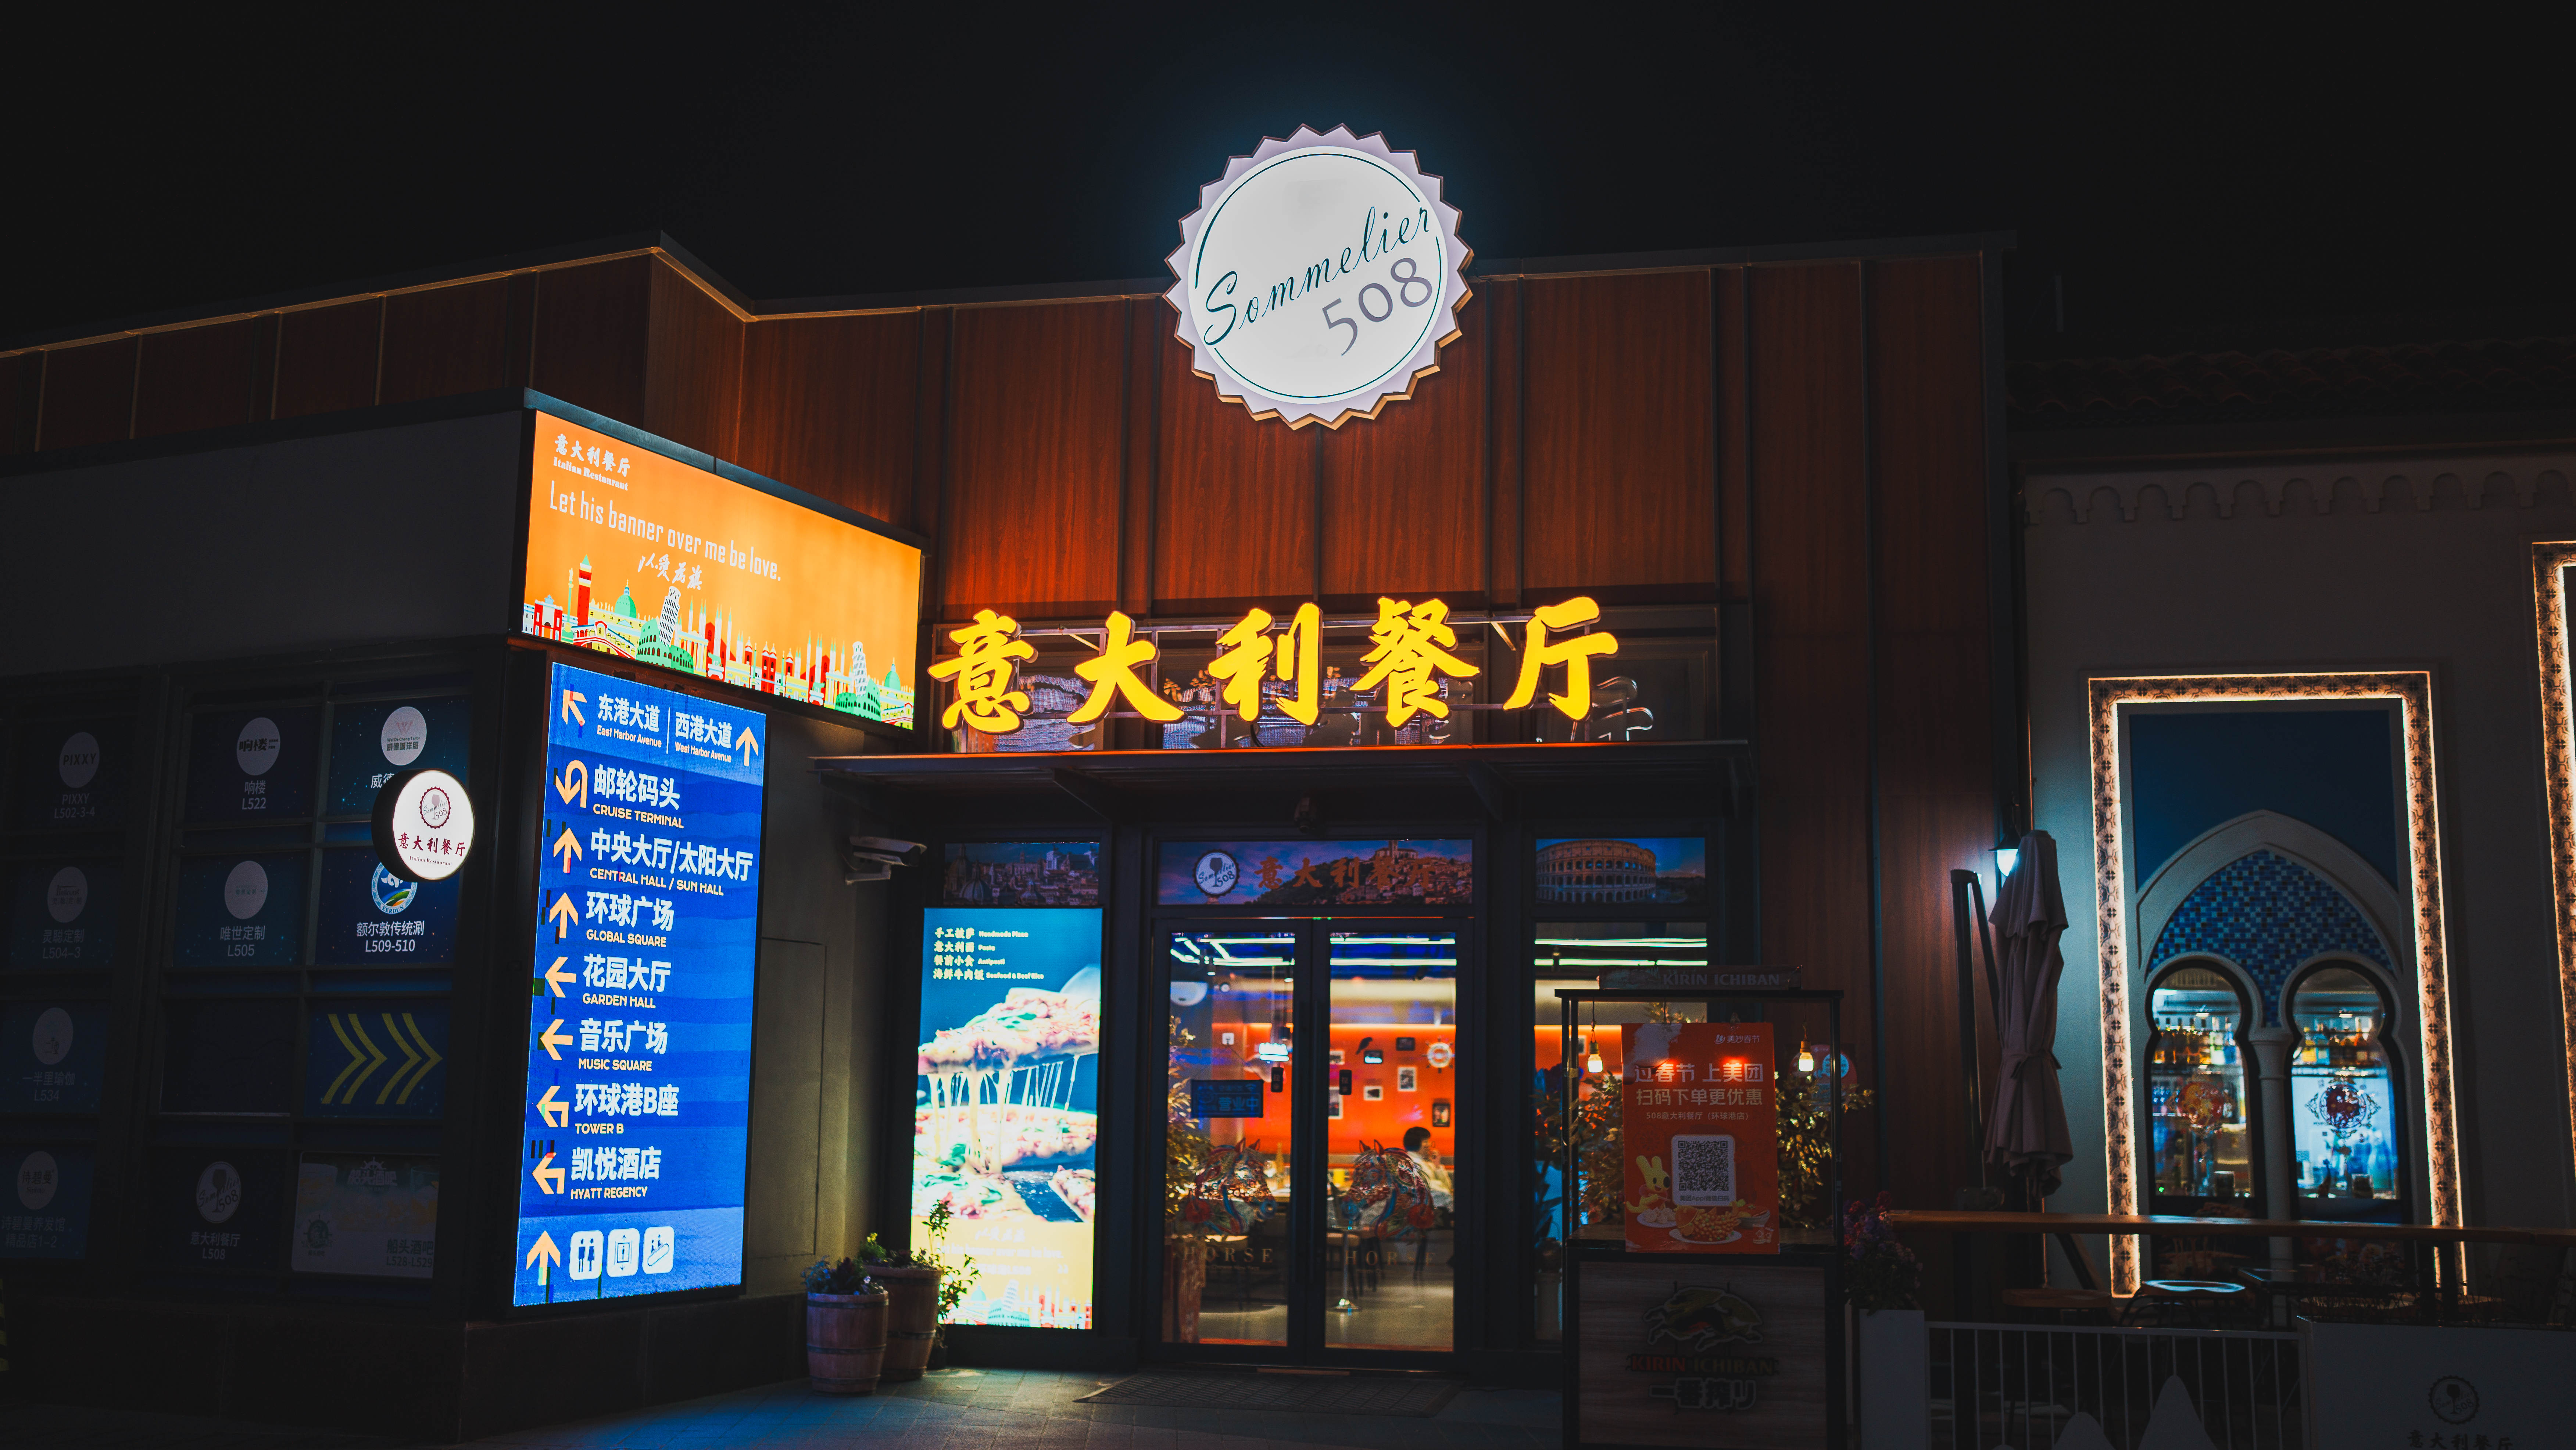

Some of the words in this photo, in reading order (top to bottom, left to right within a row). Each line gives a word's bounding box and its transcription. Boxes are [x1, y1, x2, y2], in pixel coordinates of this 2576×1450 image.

[1204, 206, 1429, 346] Sommelier
[1322, 257, 1433, 357] 508
[554, 433, 630, 477] 意大利餐厅
[553, 457, 582, 475] Italian
[583, 467, 628, 491] Restaurant
[550, 480, 576, 515] Let
[580, 491, 603, 524] his
[608, 500, 663, 542] banner
[668, 529, 701, 554] over
[705, 541, 726, 563] me
[730, 540, 746, 569] be
[750, 546, 781, 581] love.
[927, 596, 1618, 733] 意大利餐厅
[597, 693, 660, 732] 东港大道
[597, 725, 612, 737] East
[613, 729, 636, 742] Harbor
[637, 735, 662, 748] Avenue
[675, 711, 732, 749] 西港大道
[239, 738, 267, 752] 响楼
[675, 741, 690, 753] West
[690, 745, 710, 758] Harbor
[711, 749, 731, 762] Avenue
[63, 753, 96, 766] PIXXY
[244, 780, 266, 795] 响楼
[593, 764, 680, 810] 邮轮码头
[62, 793, 90, 805] PIXXY
[242, 797, 266, 810] L522
[54, 807, 95, 819] L502-3-4
[435, 807, 447, 820] 508
[593, 803, 632, 820] CRUISE
[634, 810, 684, 829] TERMINAL
[398, 832, 465, 857] 意大利餐厅
[591, 827, 754, 882] 中央大厅/太阳大厅
[1217, 870, 1235, 886] 508
[1254, 856, 1436, 889] 意大利餐厅
[590, 868, 639, 884] CENTRAL
[641, 874, 667, 888] HALL
[668, 878, 675, 890] /
[676, 879, 698, 892] SUN
[700, 883, 724, 896] HALL
[586, 890, 675, 932] 环球广场
[42, 929, 85, 944] 灵聪定制
[220, 925, 266, 941] 唯世定制
[357, 920, 425, 936] 额尔敦传统涮
[935, 927, 974, 939] 手工披萨
[365, 939, 415, 952] L509-510
[586, 929, 625, 944] GLOBAL
[627, 933, 666, 948] SQUARE
[934, 940, 974, 952] 意大利面
[42, 947, 81, 959] L504-3
[228, 944, 255, 957] L505
[583, 954, 672, 992] 花园大厅
[1663, 974, 1707, 986] KIRIN
[1714, 974, 1779, 986] ICHIBAN
[582, 993, 627, 1007] GARDEN
[629, 996, 656, 1009] HALL
[579, 1017, 668, 1054] 音乐广场
[578, 1058, 610, 1071] MUSIC
[612, 1059, 652, 1072] SQUARE
[1635, 1063, 1695, 1083] 过春节
[1702, 1063, 1763, 1083] 上美团
[34, 1089, 60, 1102] L534
[574, 1083, 679, 1117] 环球港B座
[1636, 1089, 1762, 1106] 扫码下单更优惠
[575, 1123, 613, 1135] TOWER
[616, 1123, 624, 1134] B
[570, 1146, 662, 1181] 凯悦酒店
[218, 1189, 238, 1212] 508
[570, 1188, 602, 1200] HYATT
[604, 1186, 648, 1198] REGENCY
[190, 1231, 240, 1247] 意大利餐厅
[386, 1239, 434, 1256] 船头酒吧
[202, 1248, 226, 1260] L508
[386, 1256, 433, 1268] L528-L529
[1183, 1246, 1273, 1263] HORSE
[1345, 1250, 1435, 1267] HORSE
[1631, 1356, 1686, 1372] KIRIN
[1692, 1358, 1774, 1375] ICHIBAN
